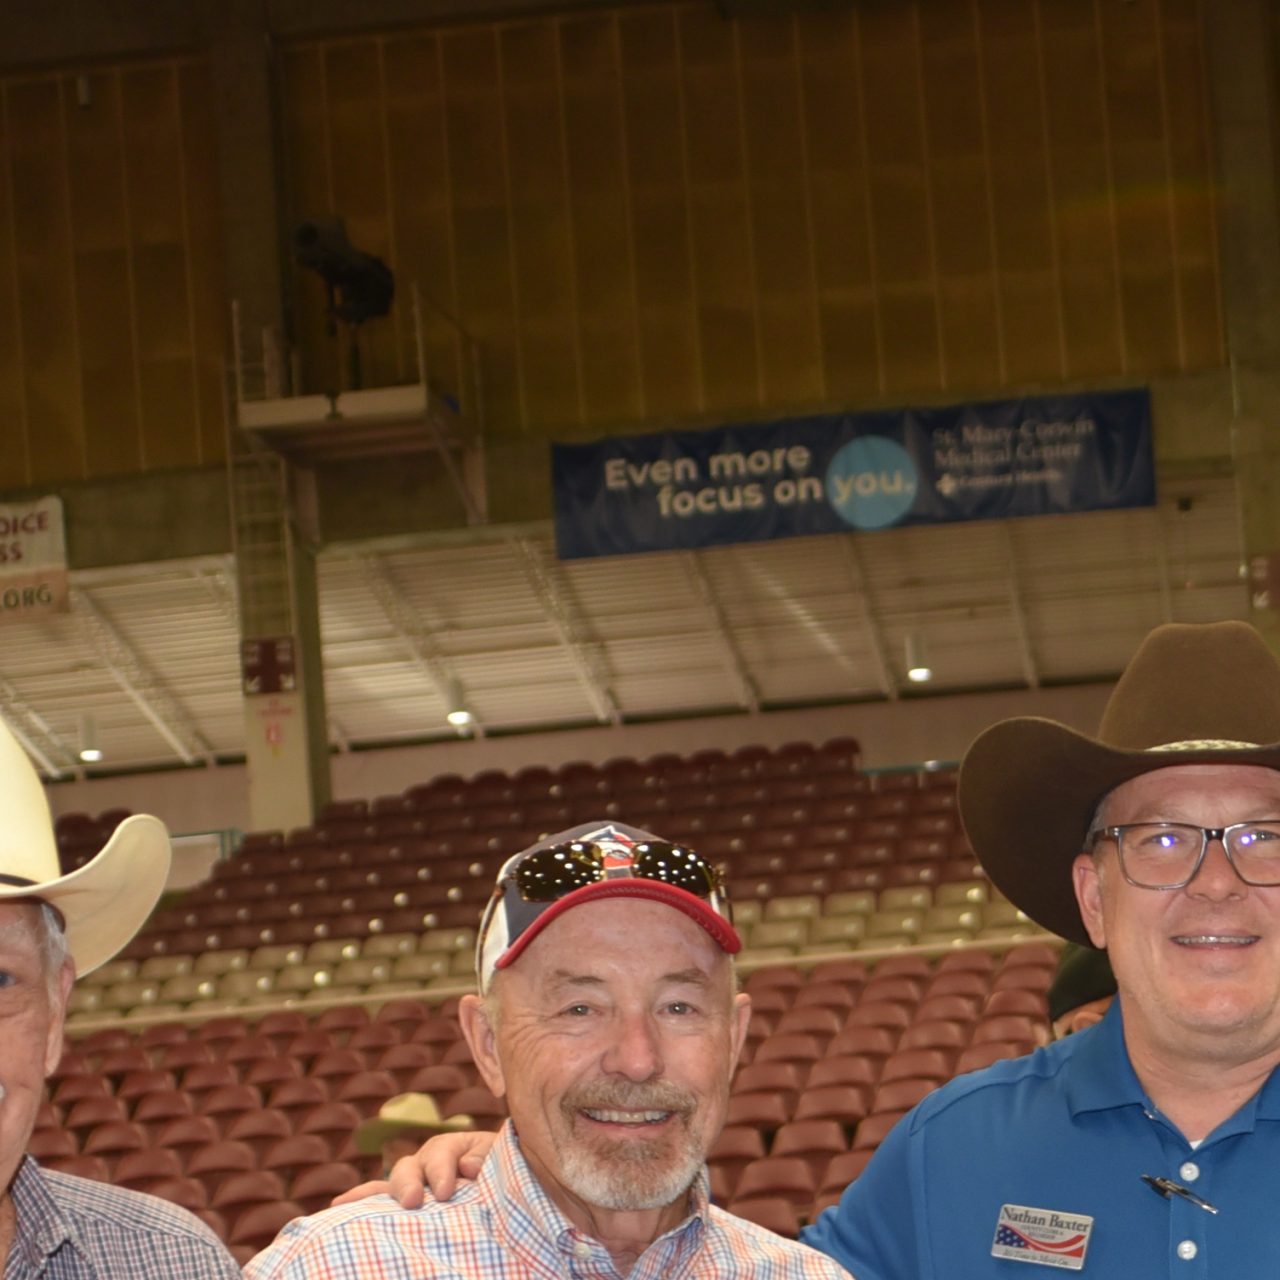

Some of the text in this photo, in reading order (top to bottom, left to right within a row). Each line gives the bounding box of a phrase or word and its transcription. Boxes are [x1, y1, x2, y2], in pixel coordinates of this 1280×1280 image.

[605, 444, 811, 490] Even more
[657, 476, 765, 519] focus
[773, 475, 824, 504] on
[832, 468, 914, 507] you.
[1002, 1206, 1046, 1226] Nathan
[1049, 1213, 1089, 1232] Baxter
